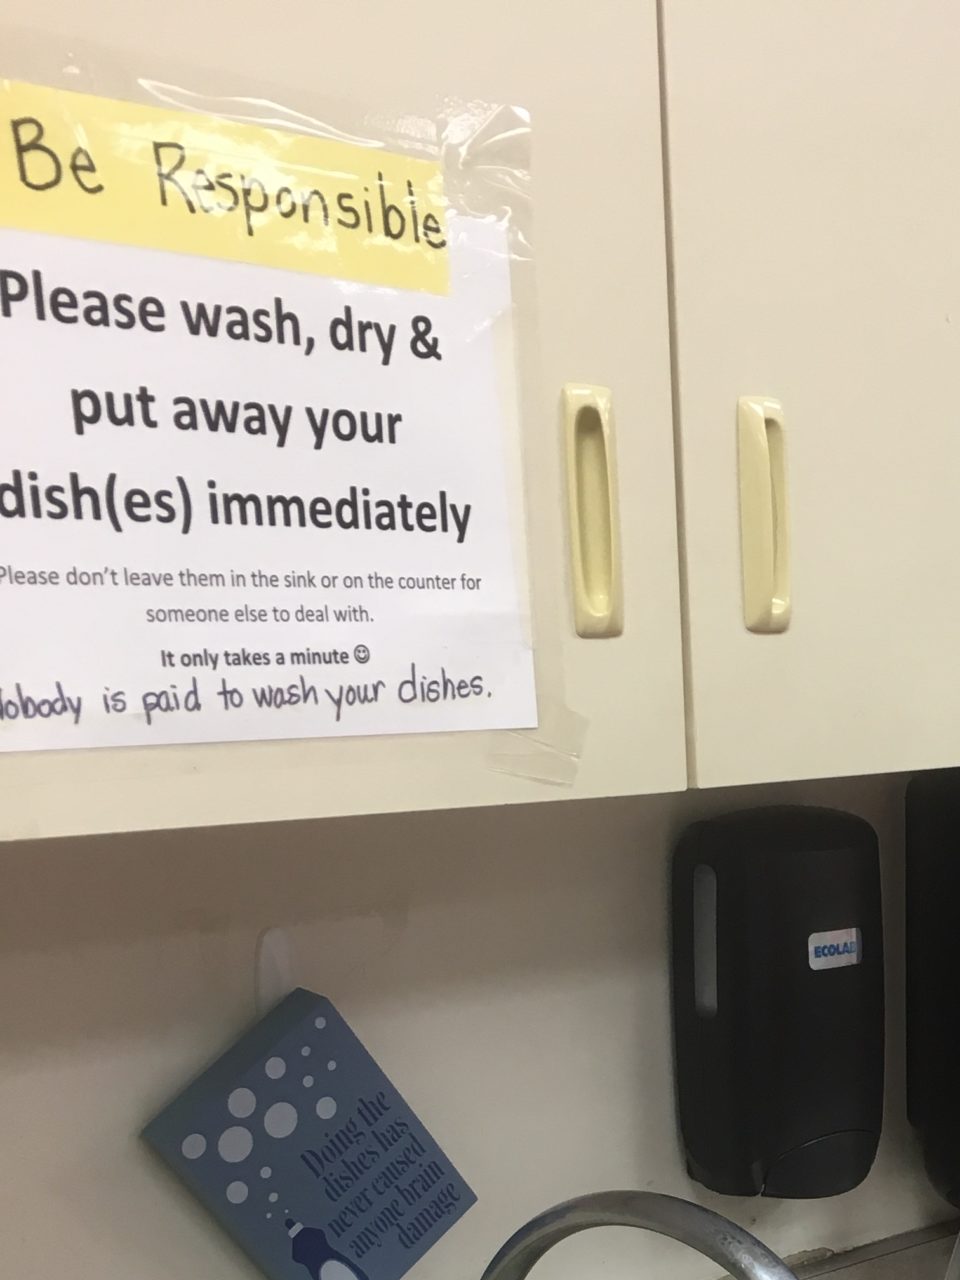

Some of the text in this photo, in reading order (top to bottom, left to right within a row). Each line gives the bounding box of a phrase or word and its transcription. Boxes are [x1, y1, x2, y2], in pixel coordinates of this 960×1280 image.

[10, 118, 447, 249] Be Responsible
[0, 270, 442, 365] Please wash, dry &
[71, 386, 403, 450] put away your
[0, 469, 471, 543] dish(es) immediately
[66, 566, 118, 586] don’t
[123, 567, 174, 587] leave
[178, 568, 226, 588] them
[230, 569, 247, 588] in
[251, 569, 279, 588] the
[284, 570, 316, 589] sink
[321, 574, 338, 589] or
[343, 574, 364, 589] on
[368, 571, 394, 590] the
[398, 573, 456, 591] counter
[460, 573, 482, 591] for
[146, 604, 374, 623] someone else to deal with.
[103, 686, 127, 714] is
[142, 676, 202, 725] paid
[217, 678, 244, 711] to
[252, 674, 319, 709] wash
[325, 679, 386, 722] your
[398, 662, 492, 704] dishes.
[161, 648, 349, 670] It only takes a minute
[300, 1091, 391, 1179] Doing the
[322, 1116, 409, 1202] dishes has
[328, 1132, 427, 1238] never caused
[350, 1161, 445, 1259] anyone brain
[396, 1182, 461, 1249] damage
